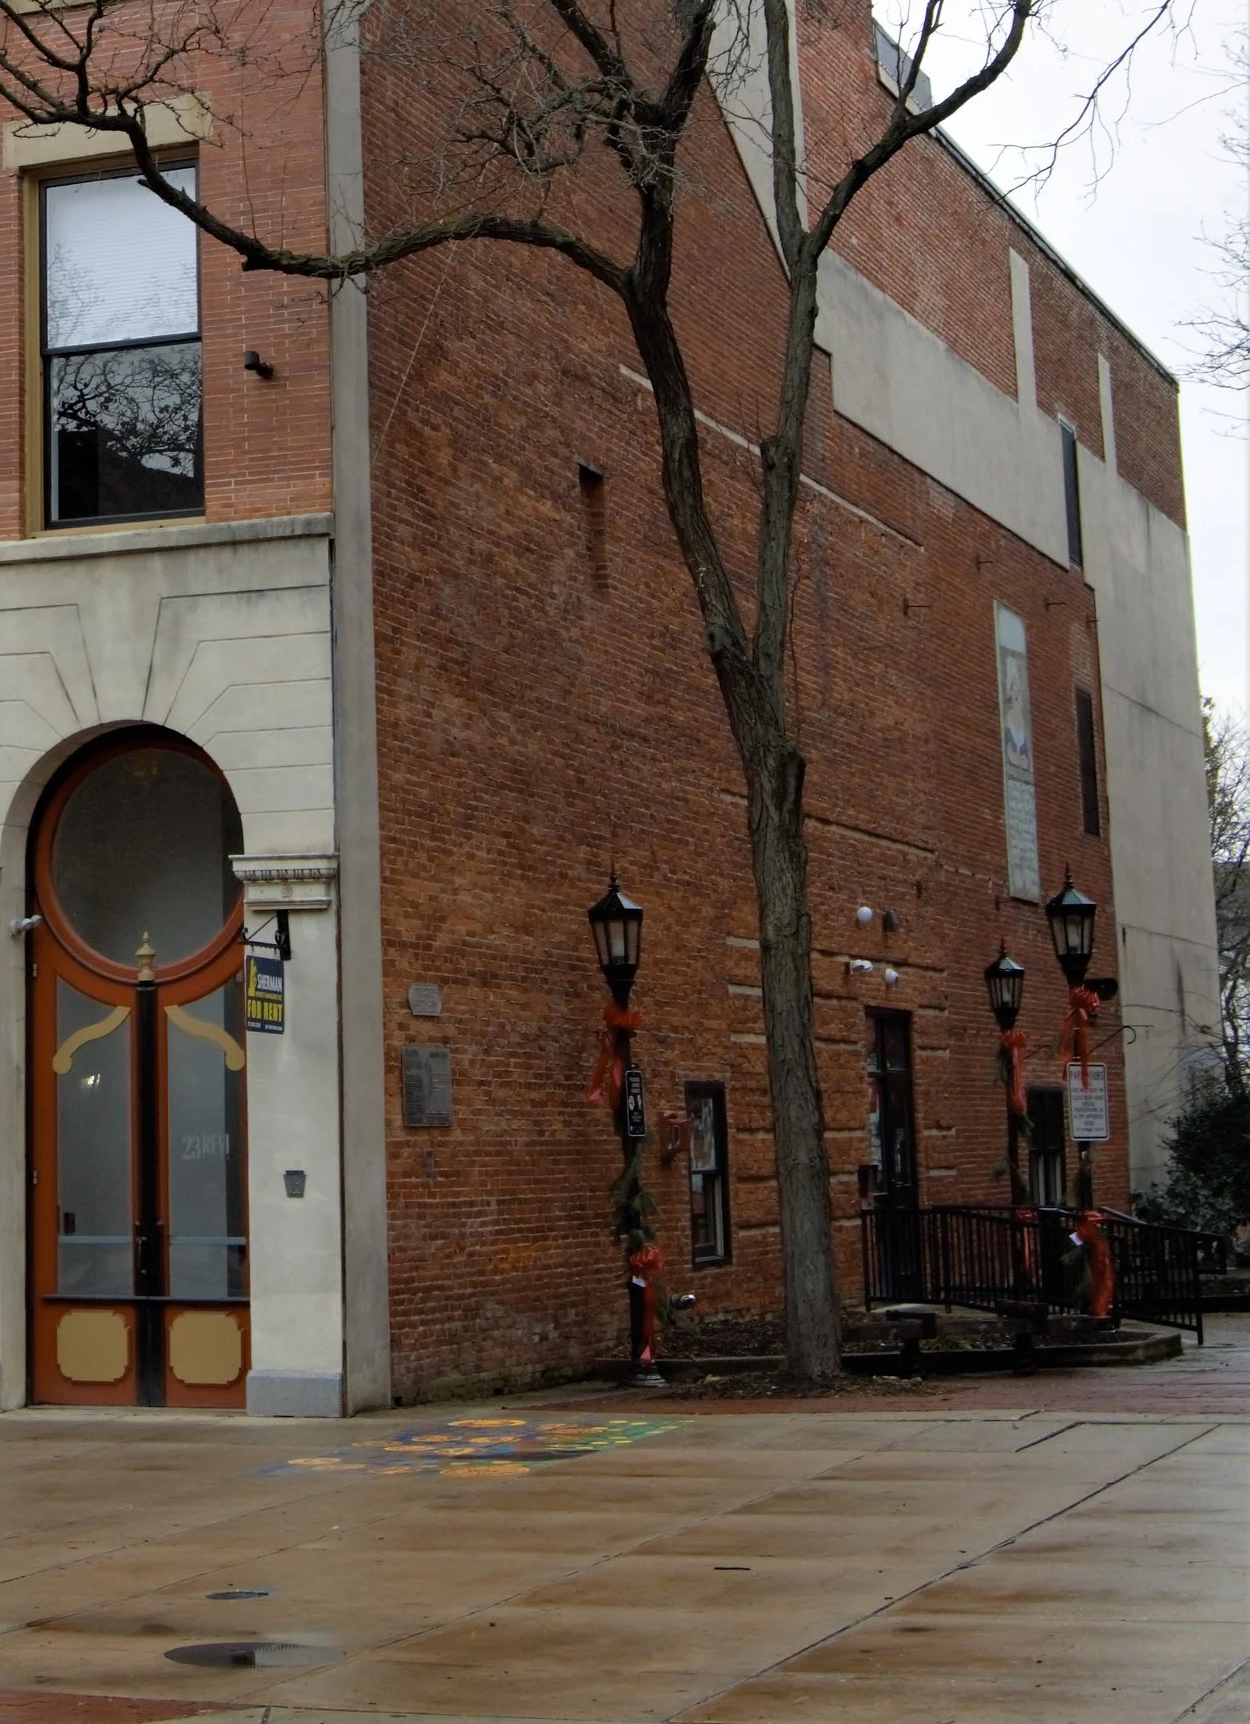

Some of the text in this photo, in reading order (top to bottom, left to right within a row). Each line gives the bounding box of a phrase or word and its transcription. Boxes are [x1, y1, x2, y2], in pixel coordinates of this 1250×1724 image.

[257, 974, 283, 993] SHERMAN
[248, 999, 283, 1022] FOR RENT
